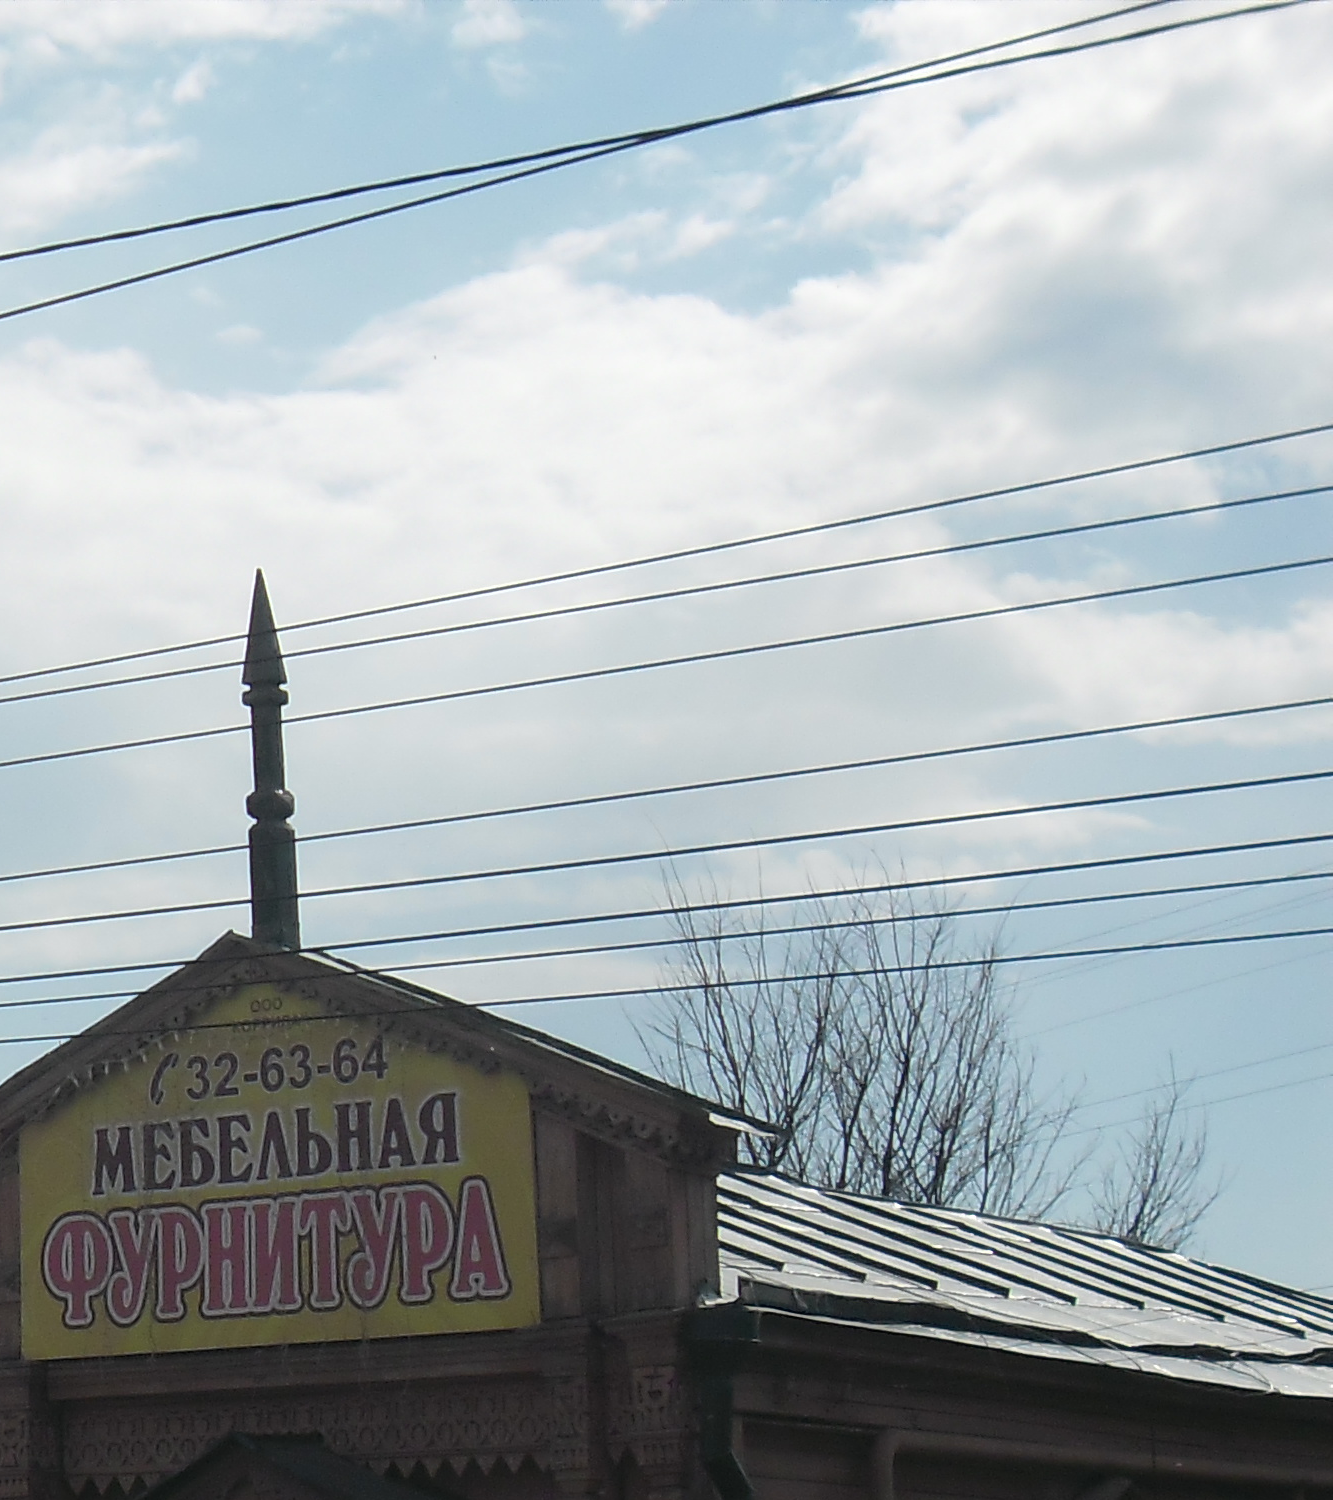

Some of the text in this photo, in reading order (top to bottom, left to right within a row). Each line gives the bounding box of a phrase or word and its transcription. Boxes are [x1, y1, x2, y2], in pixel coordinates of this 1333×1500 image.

[186, 1036, 388, 1101] 32-63-64
[91, 1091, 460, 1197] МЕБЕЛЬНАЯ
[41, 1174, 511, 1329] ФУРНИТУРА
